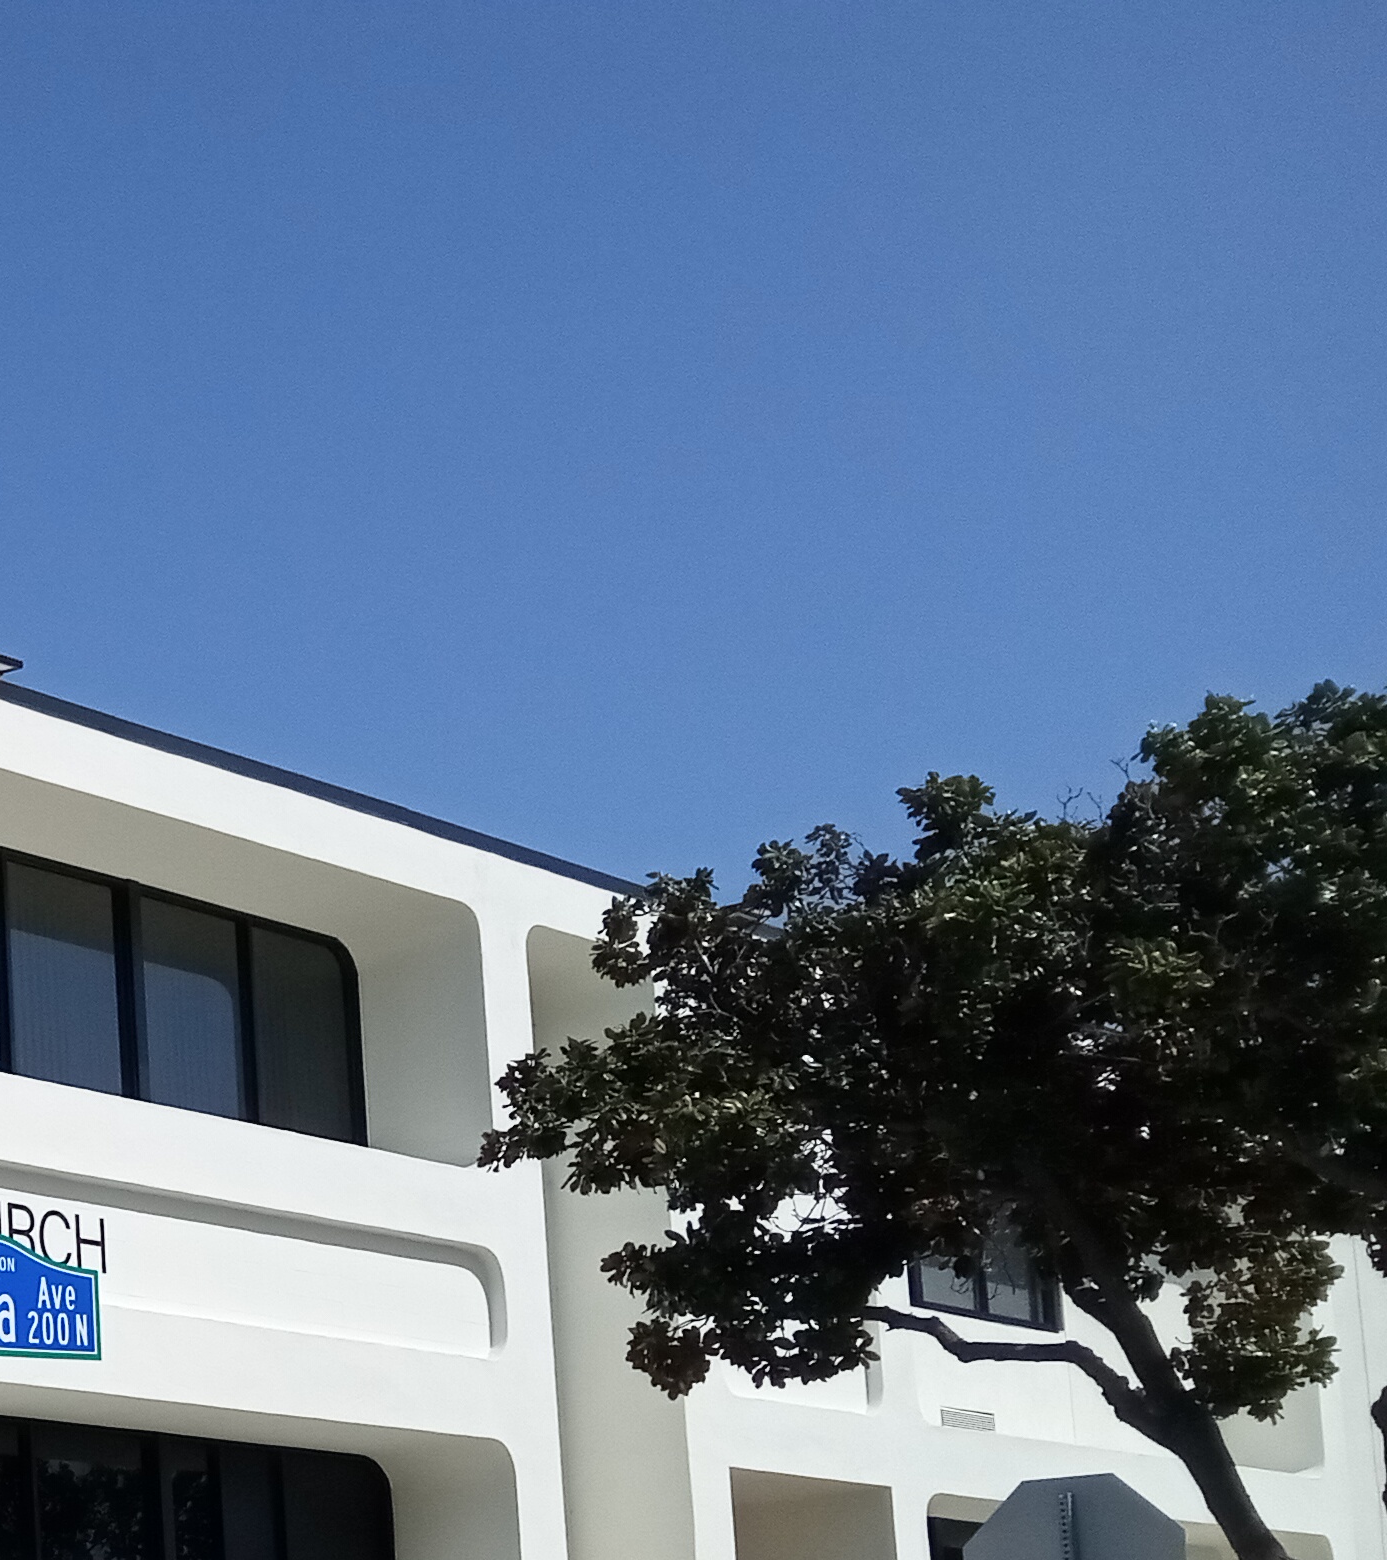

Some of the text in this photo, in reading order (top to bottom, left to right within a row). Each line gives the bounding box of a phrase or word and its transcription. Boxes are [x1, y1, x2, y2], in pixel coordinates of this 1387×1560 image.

[37, 1276, 77, 1312] Ave
[27, 1311, 89, 1347] 200 N
